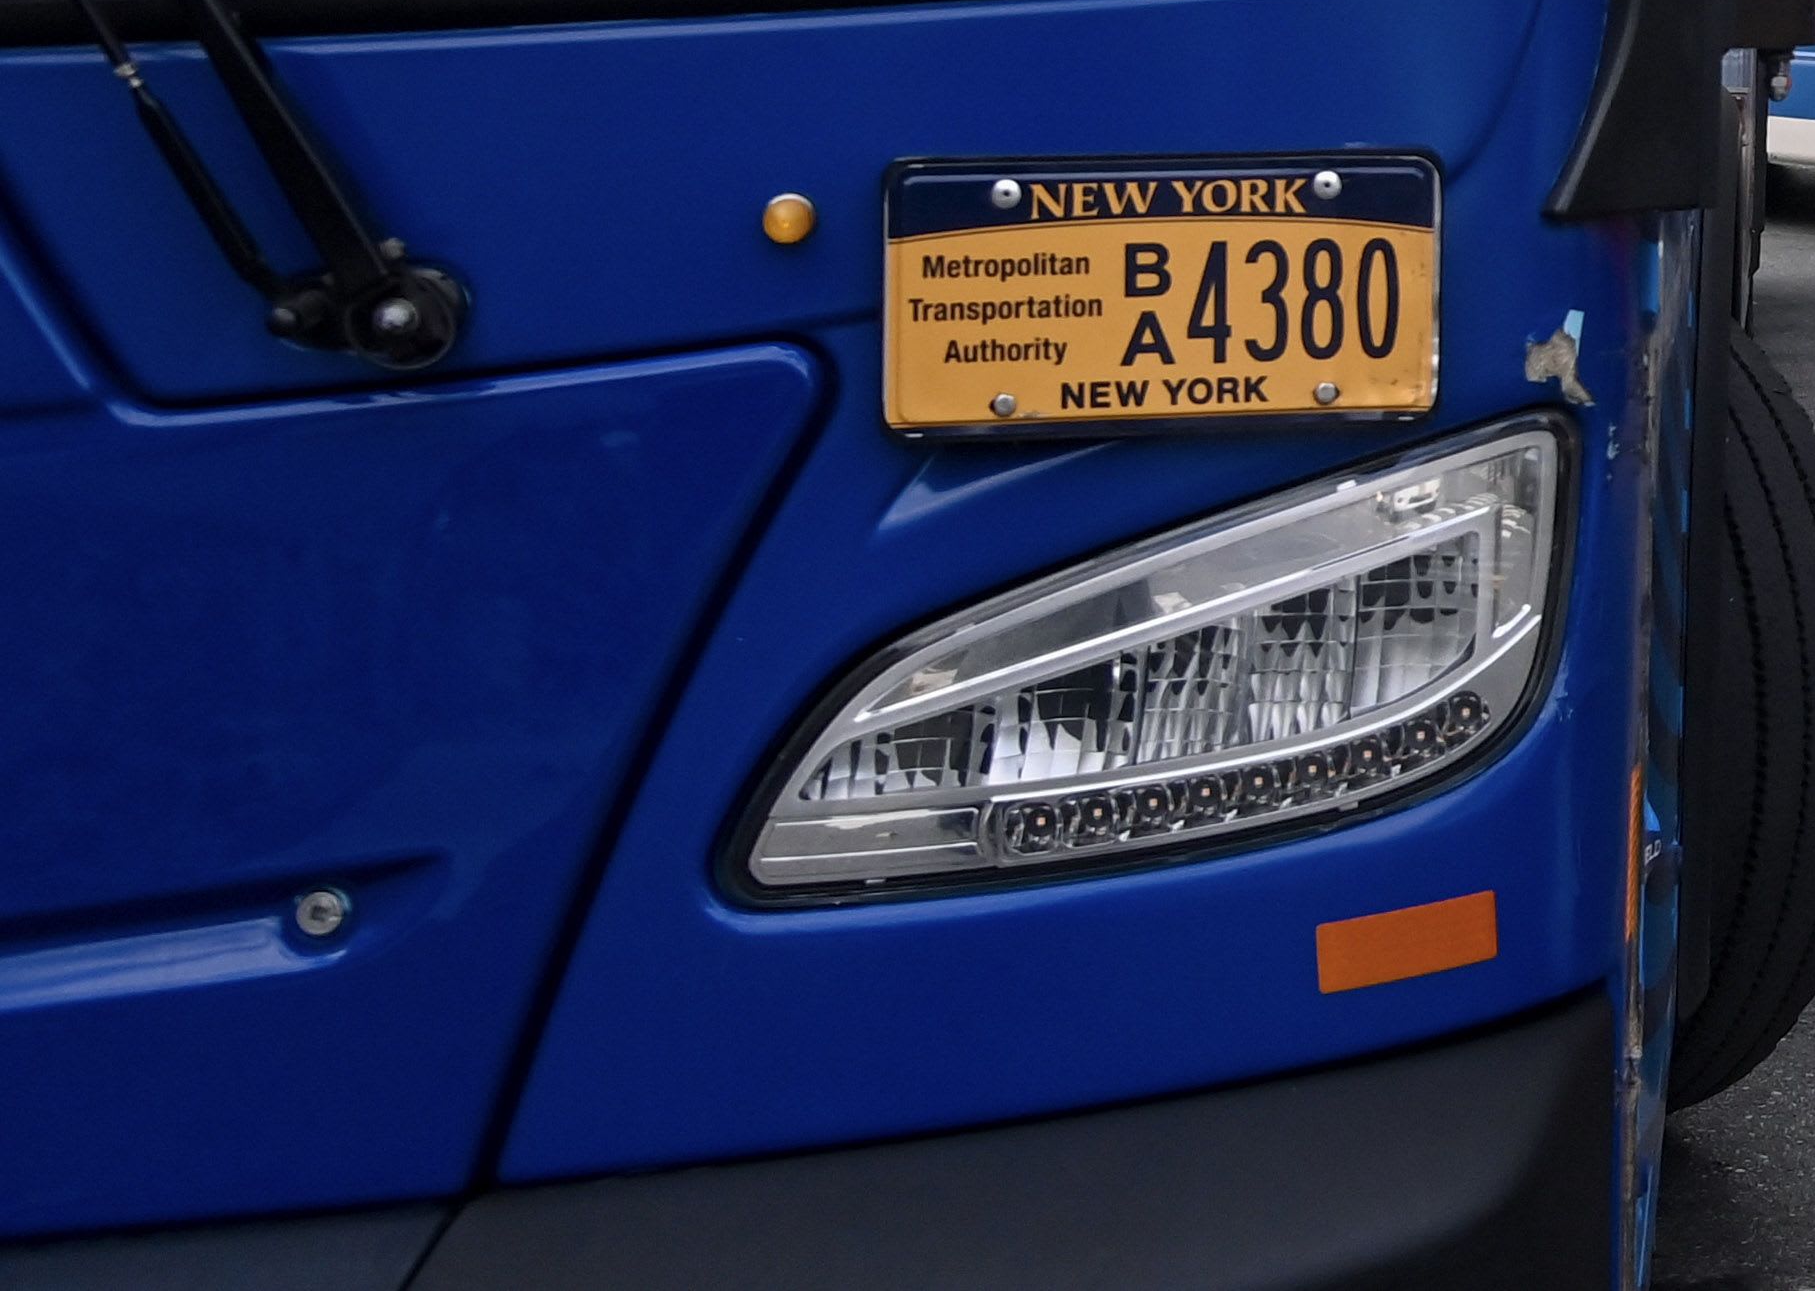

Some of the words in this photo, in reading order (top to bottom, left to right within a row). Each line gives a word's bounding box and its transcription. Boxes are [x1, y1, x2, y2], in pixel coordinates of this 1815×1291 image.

[1030, 180, 1158, 220] NEW
[1171, 177, 1309, 215] YORK
[921, 253, 1091, 282] Metropolitan
[908, 295, 1104, 325] Transportation
[1186, 237, 1399, 365] 4380
[944, 338, 1068, 367] Authority
[1060, 379, 1150, 410] NEW
[1161, 376, 1269, 406] YORK
